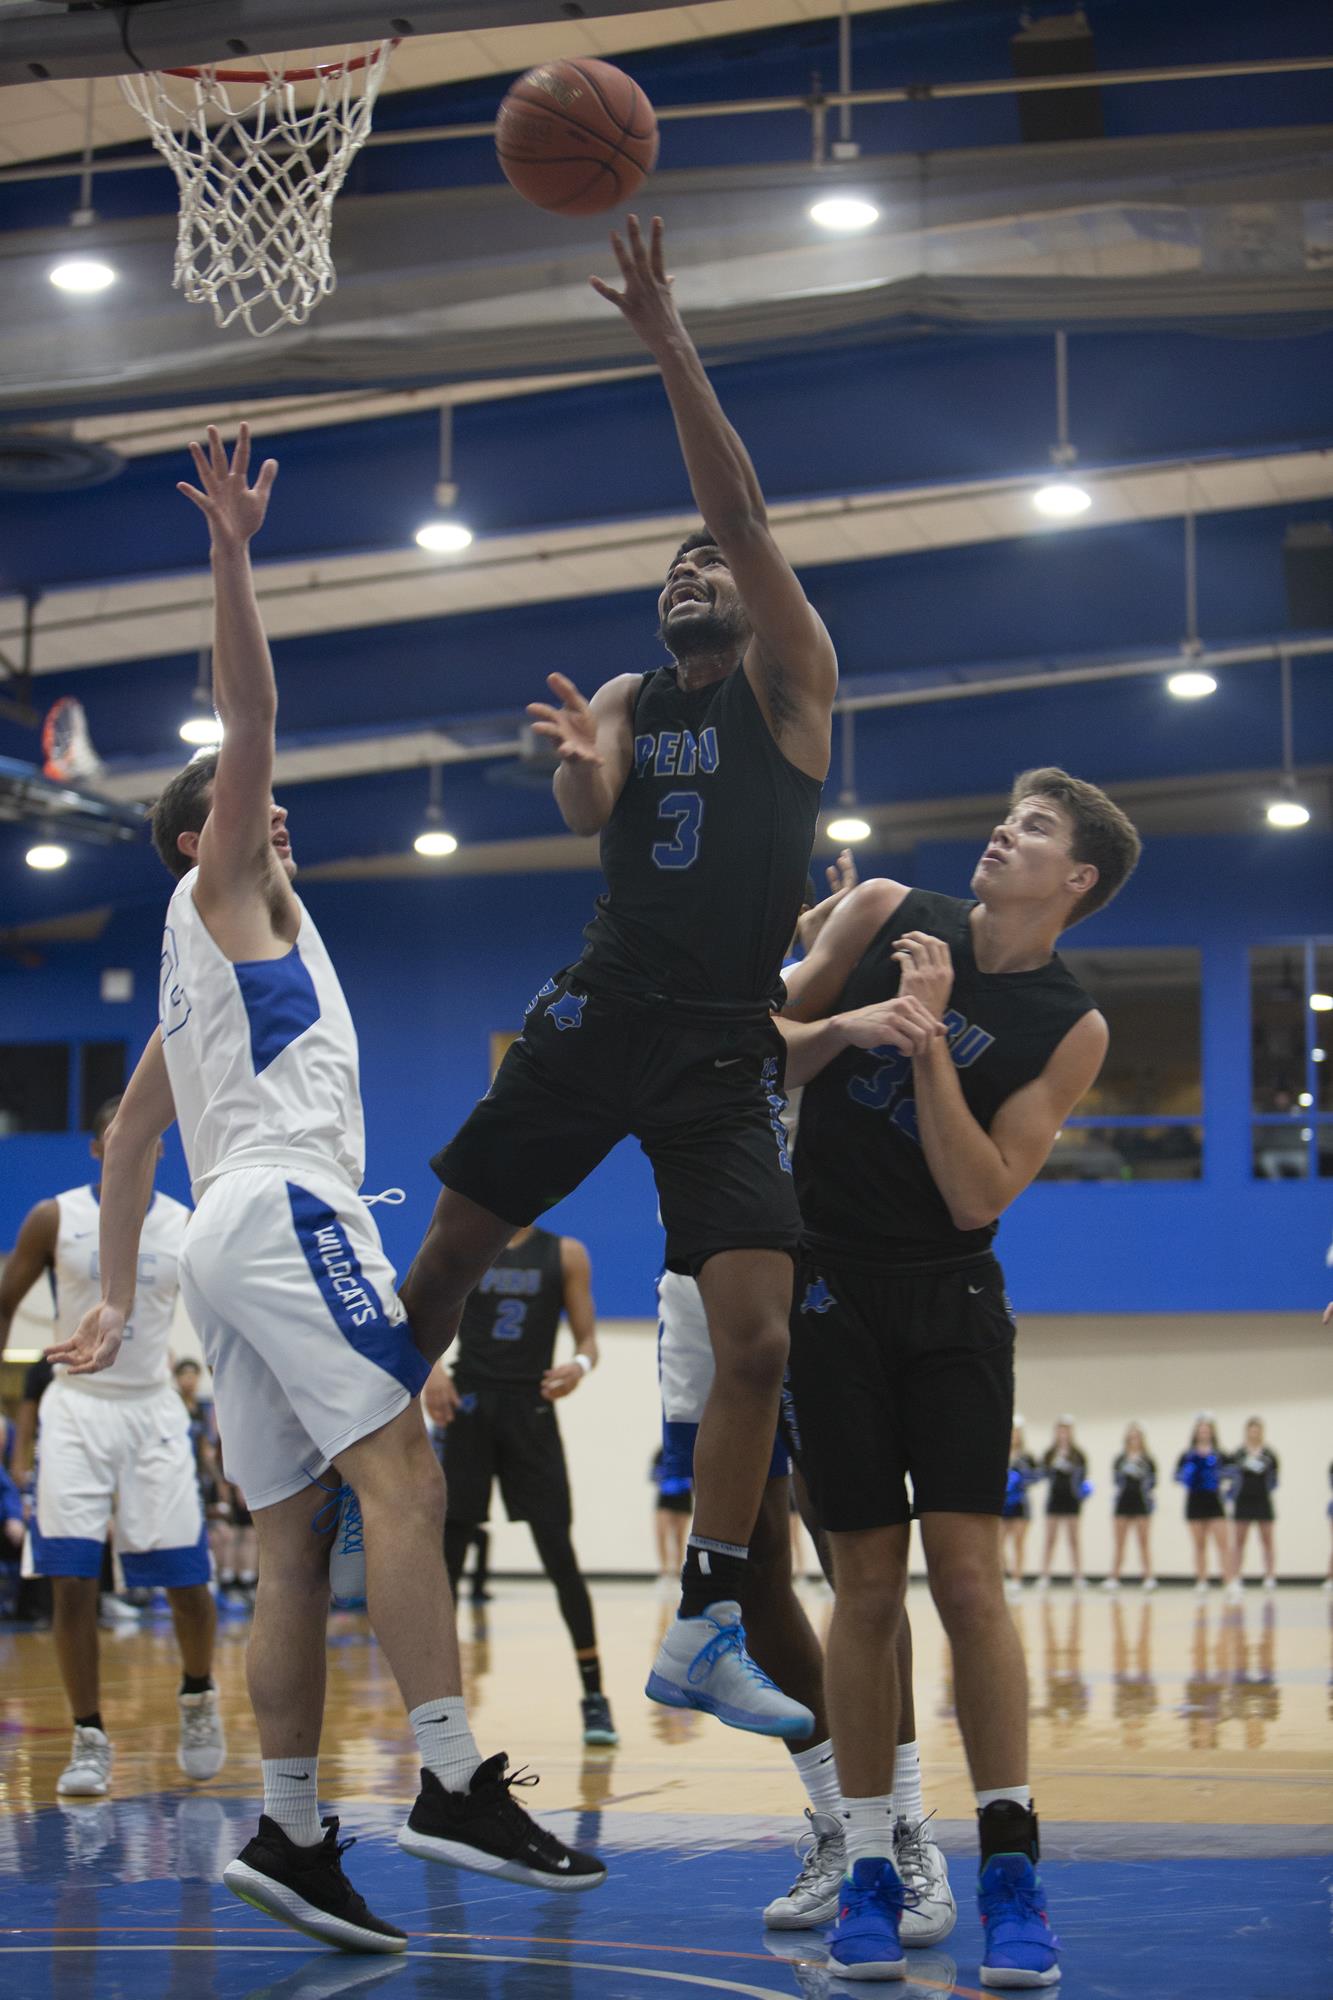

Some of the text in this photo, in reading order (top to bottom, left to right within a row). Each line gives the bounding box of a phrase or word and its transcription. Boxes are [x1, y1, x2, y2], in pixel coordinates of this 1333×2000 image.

[634, 726, 720, 778] PERU
[651, 790, 704, 869] 3
[311, 1224, 379, 1328] WILDCATS
[491, 1297, 528, 1341] 2
